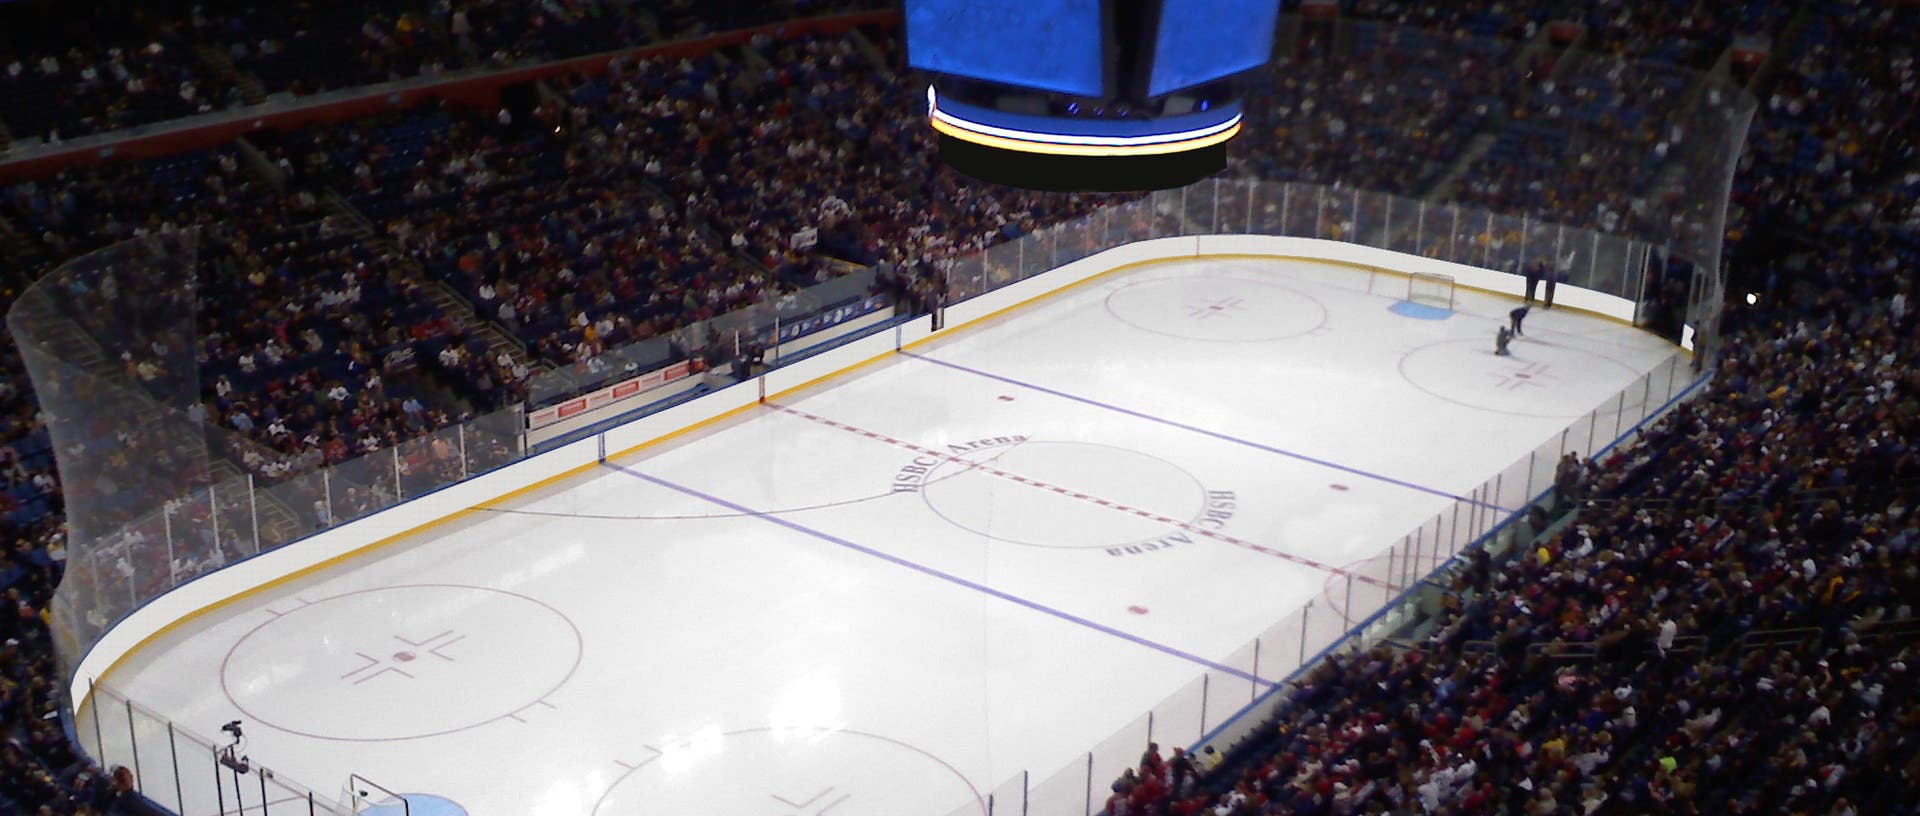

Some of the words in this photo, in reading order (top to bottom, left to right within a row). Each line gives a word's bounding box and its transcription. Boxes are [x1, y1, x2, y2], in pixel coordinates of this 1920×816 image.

[893, 456, 937, 493] HSBC
[947, 435, 1028, 453] Arena
[1198, 490, 1236, 529] HSBC
[1106, 532, 1193, 557] Arena
